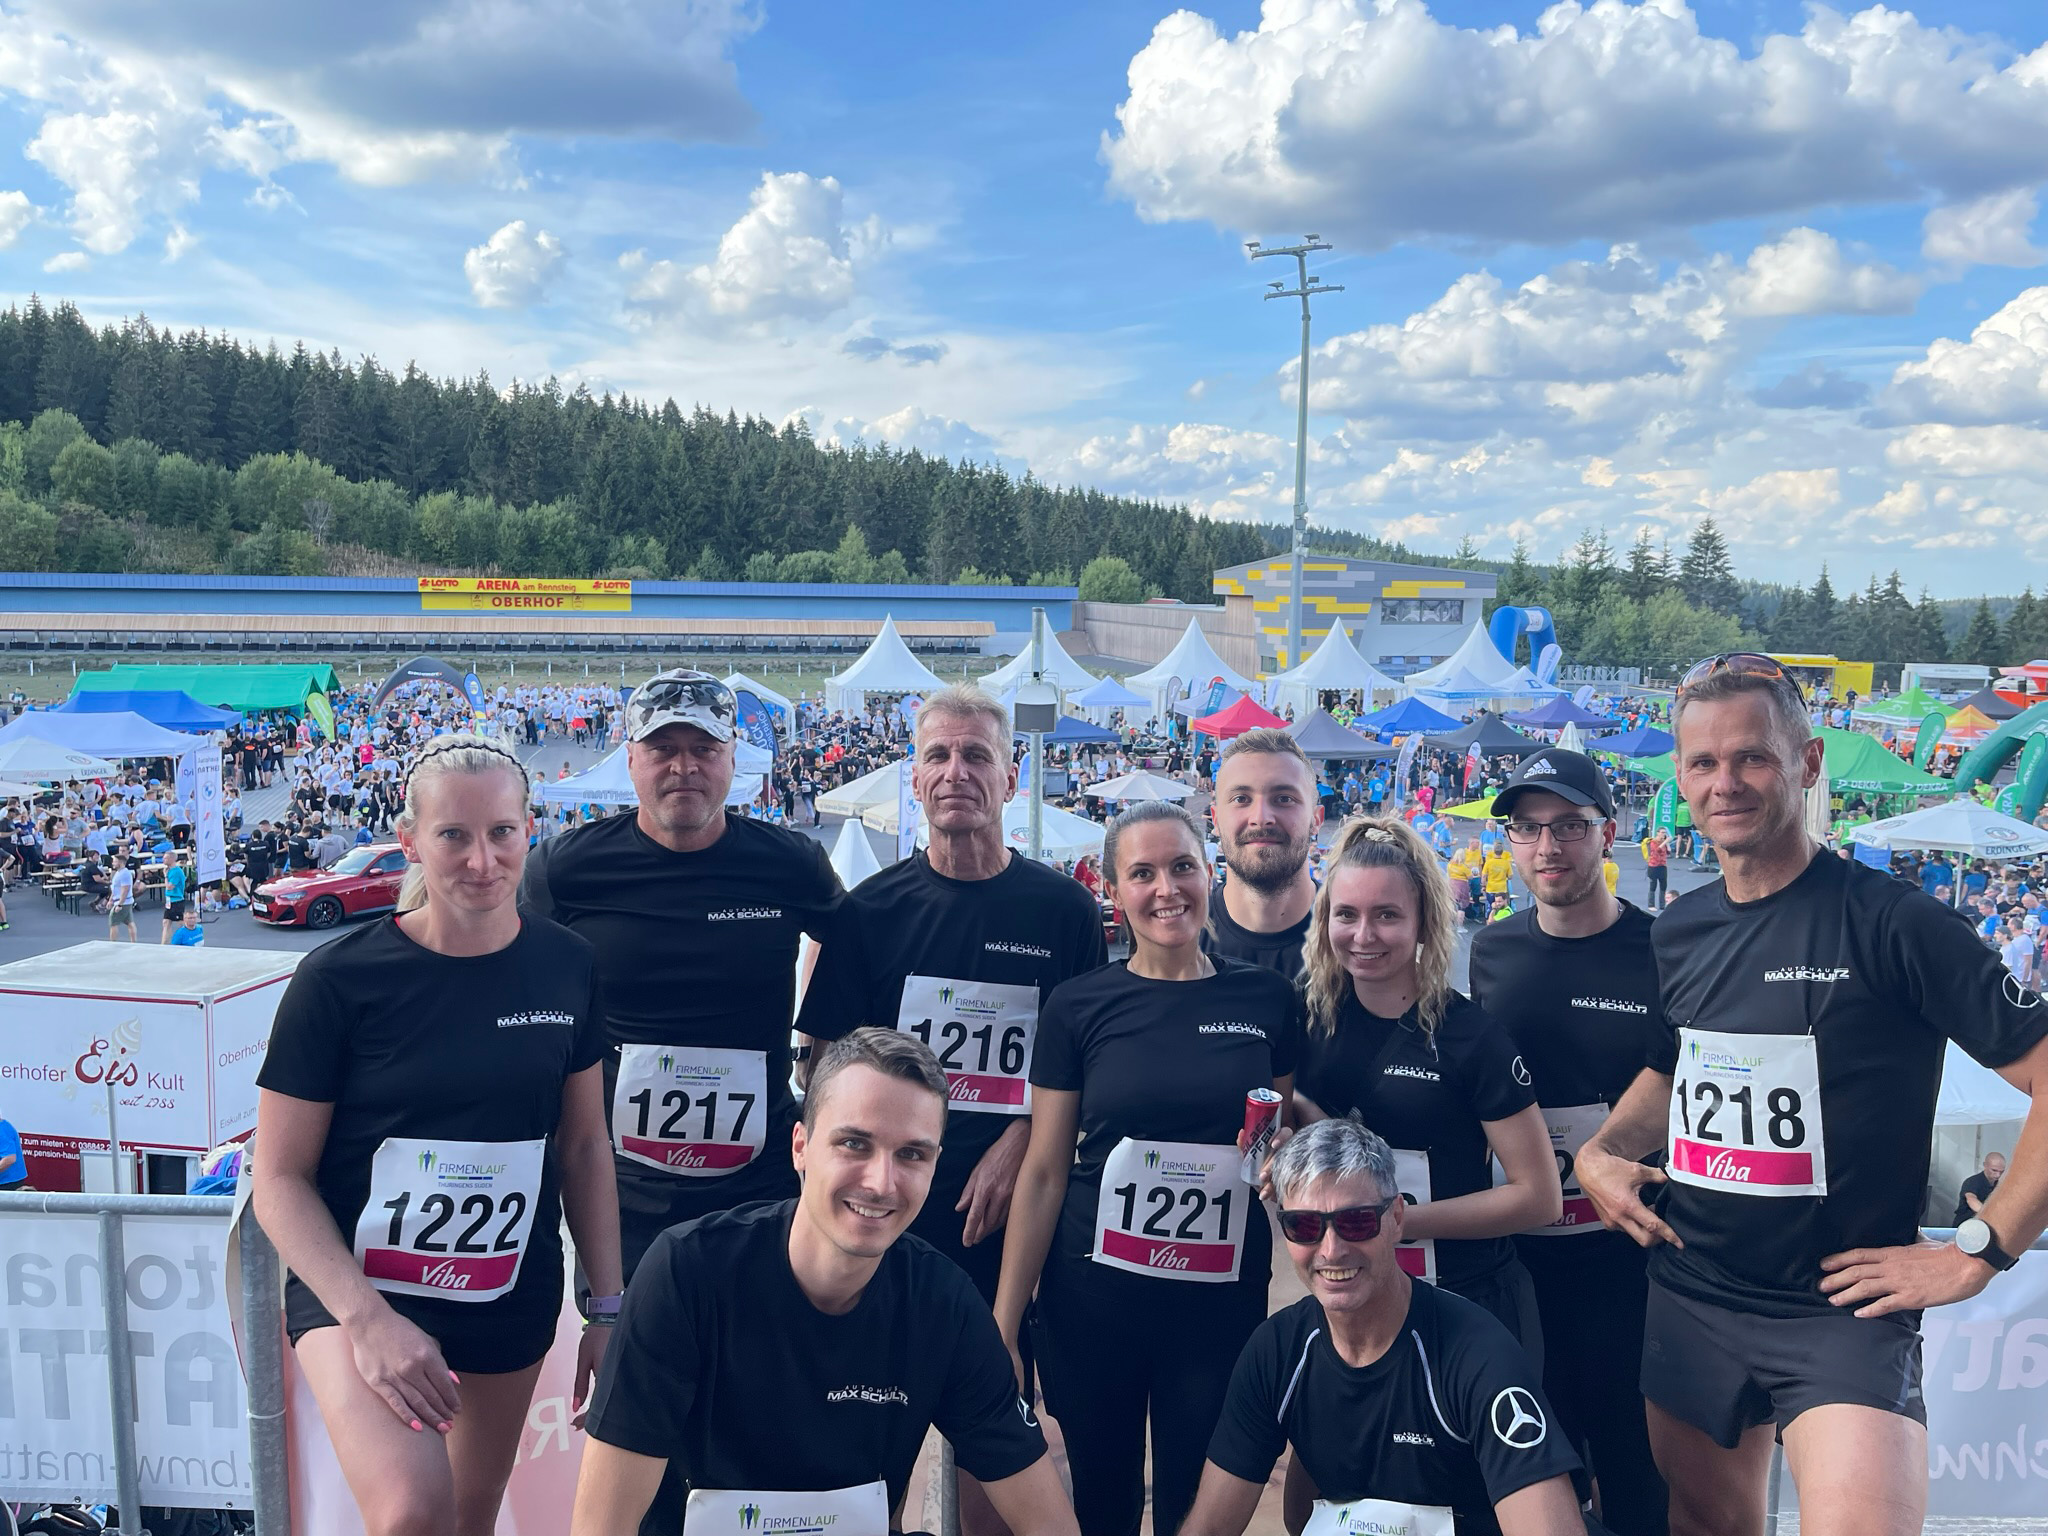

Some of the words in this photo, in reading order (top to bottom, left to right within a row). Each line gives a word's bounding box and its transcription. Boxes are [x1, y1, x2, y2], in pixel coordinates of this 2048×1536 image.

[476, 580, 520, 590] ARENA
[538, 583, 576, 593] Rennsteig
[604, 582, 630, 590] LOTTO
[492, 596, 564, 608] OBERHOF
[1524, 767, 1557, 779] adidas
[1850, 780, 1883, 790] DEKRA
[1916, 782, 1949, 792] DEKRA
[1662, 784, 1673, 823] DEKRA
[2002, 792, 2013, 817] KRA
[1985, 844, 2032, 856] ERDINGER
[1010, 946, 1051, 958] SCHULTZ
[1765, 972, 1794, 980] MAX
[955, 997, 1006, 1010] FIRMENLAUF
[1572, 1000, 1597, 1008] MAX
[1599, 1002, 1647, 1013] SCHULTZ
[497, 1016, 528, 1026] MAX
[530, 1015, 574, 1024] SCHULTZ
[1227, 1026, 1266, 1038] SCHULTZ
[218, 1039, 269, 1067] Oberhofe
[911, 1018, 1026, 1075] 1216
[75, 1035, 138, 1087] Eis
[1703, 1052, 1765, 1067] FIRMENLAUF
[2, 1063, 66, 1082] erhofer
[148, 1072, 184, 1091] Kult
[676, 1065, 732, 1076] FIRMENLAUF
[1394, 1069, 1440, 1080] SCHULTZ
[119, 1094, 142, 1108] seit
[220, 1112, 242, 1129] Eiskult
[243, 1106, 257, 1119] zum
[629, 1088, 755, 1142] 1217
[1677, 1078, 1806, 1149] 1218
[40, 1139, 64, 1148] mieten
[1250, 1125, 1276, 1160] PFEIL
[666, 1144, 706, 1167] Viba
[438, 1163, 507, 1174] FIRMENLAUF
[1162, 1161, 1216, 1172] FIRMENLAUF
[1706, 1150, 1751, 1181] Viba
[1114, 1182, 1232, 1240] 1221
[383, 1191, 527, 1253] 1222
[1148, 1243, 1190, 1269] Viba
[421, 1258, 471, 1288] Viba
[827, 1390, 859, 1400] MAX
[861, 1391, 908, 1405] SCHULTZ
[763, 1514, 839, 1528] FIRMENLAUF
[1350, 1520, 1408, 1536] FIRMENLAUF
